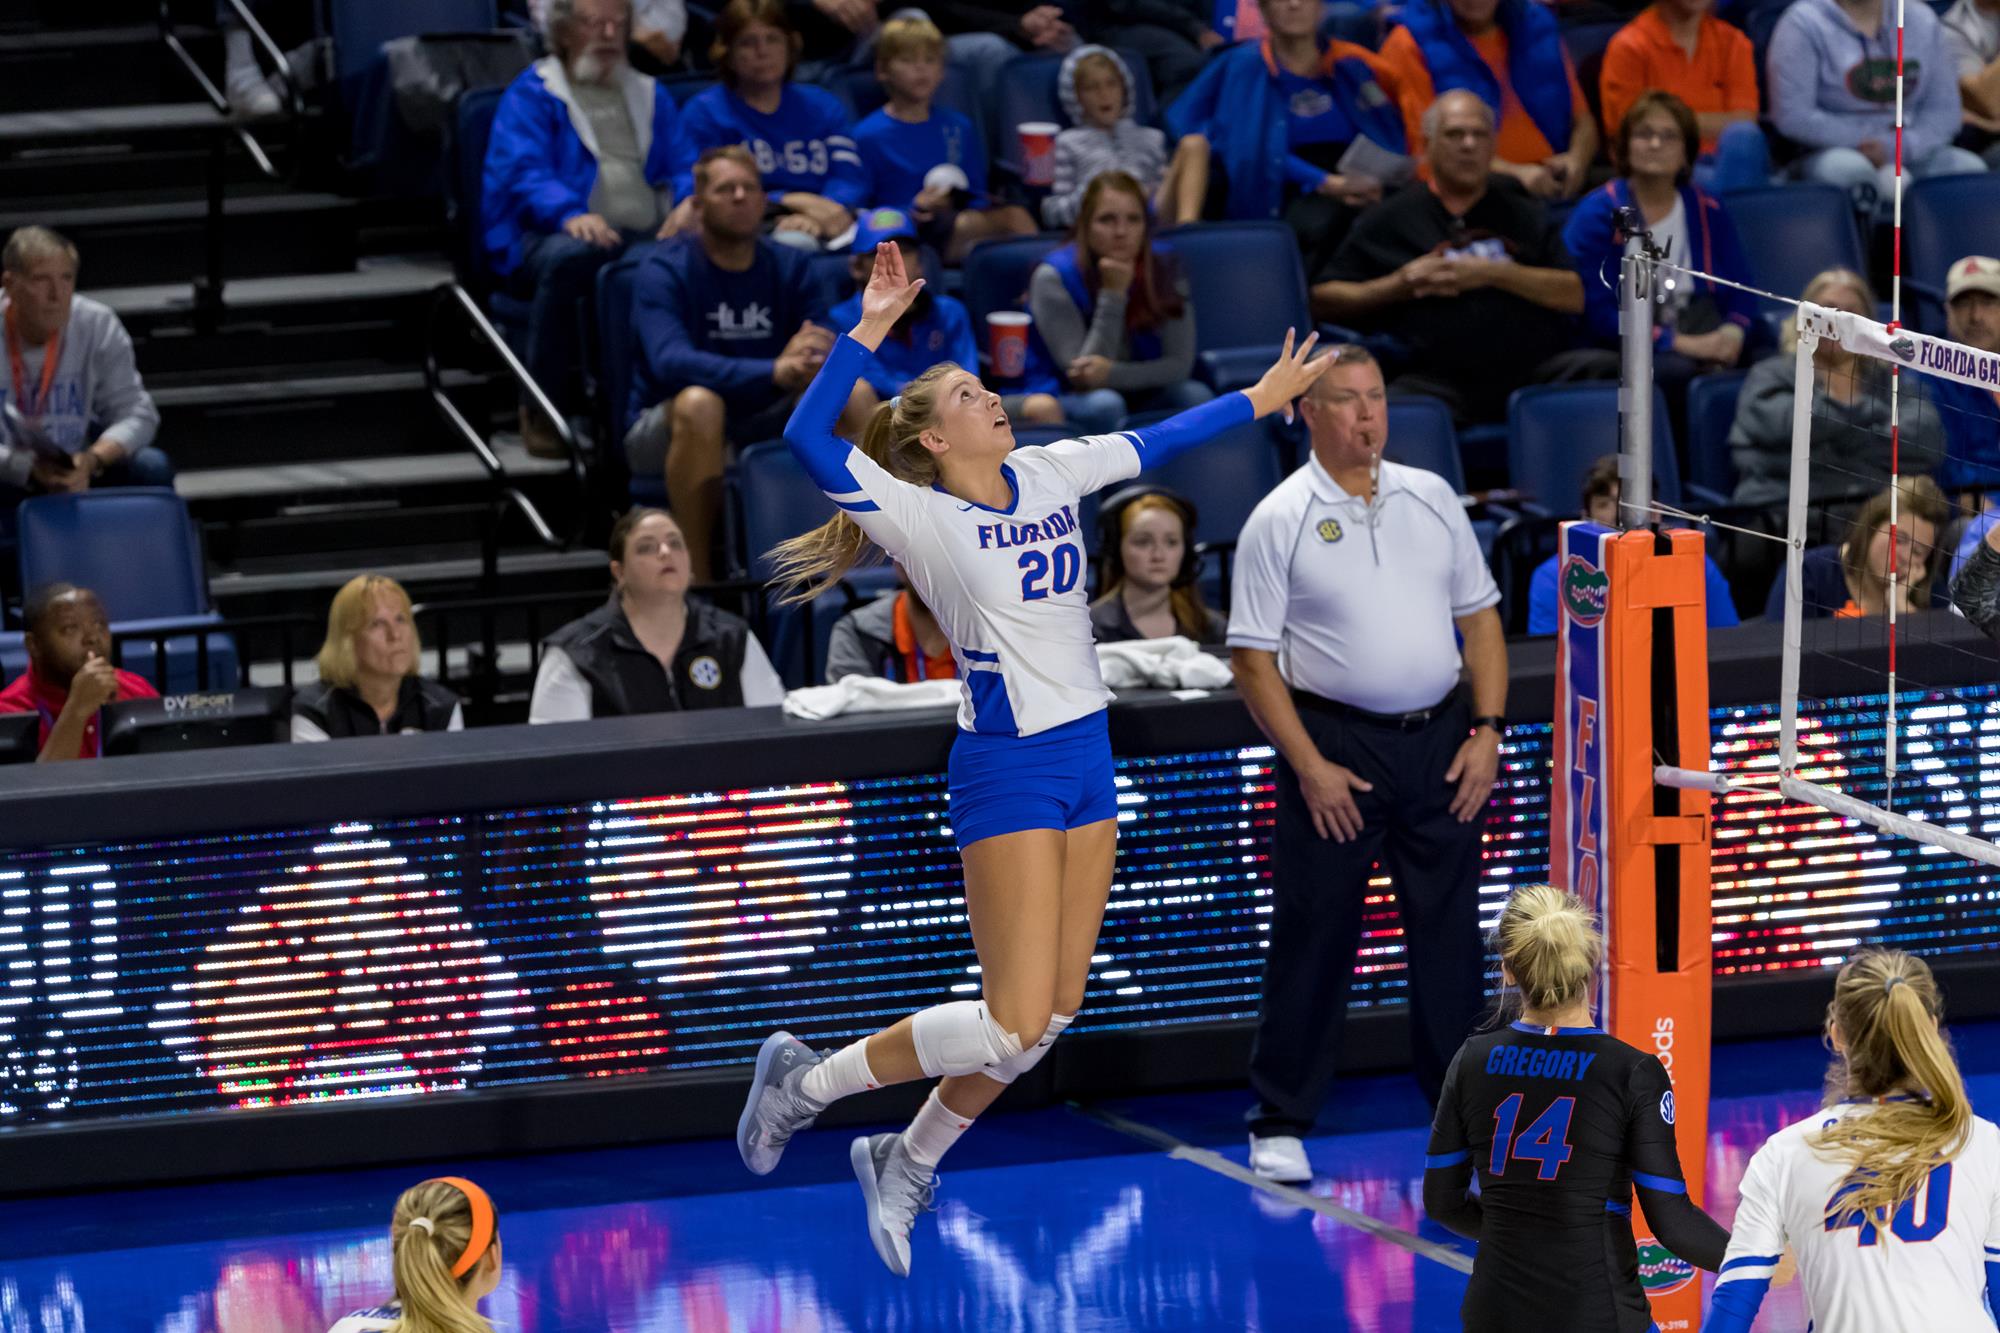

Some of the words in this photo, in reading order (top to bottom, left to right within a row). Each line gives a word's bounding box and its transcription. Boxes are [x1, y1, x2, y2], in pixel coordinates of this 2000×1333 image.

[1920, 340, 1976, 379] FLORIDA
[1979, 357, 2000, 386] GA
[976, 504, 1077, 549] FLORIDA
[1017, 542, 1080, 602] 20
[1486, 1044, 1597, 1081] GREGORY
[1488, 1092, 1576, 1181] 14
